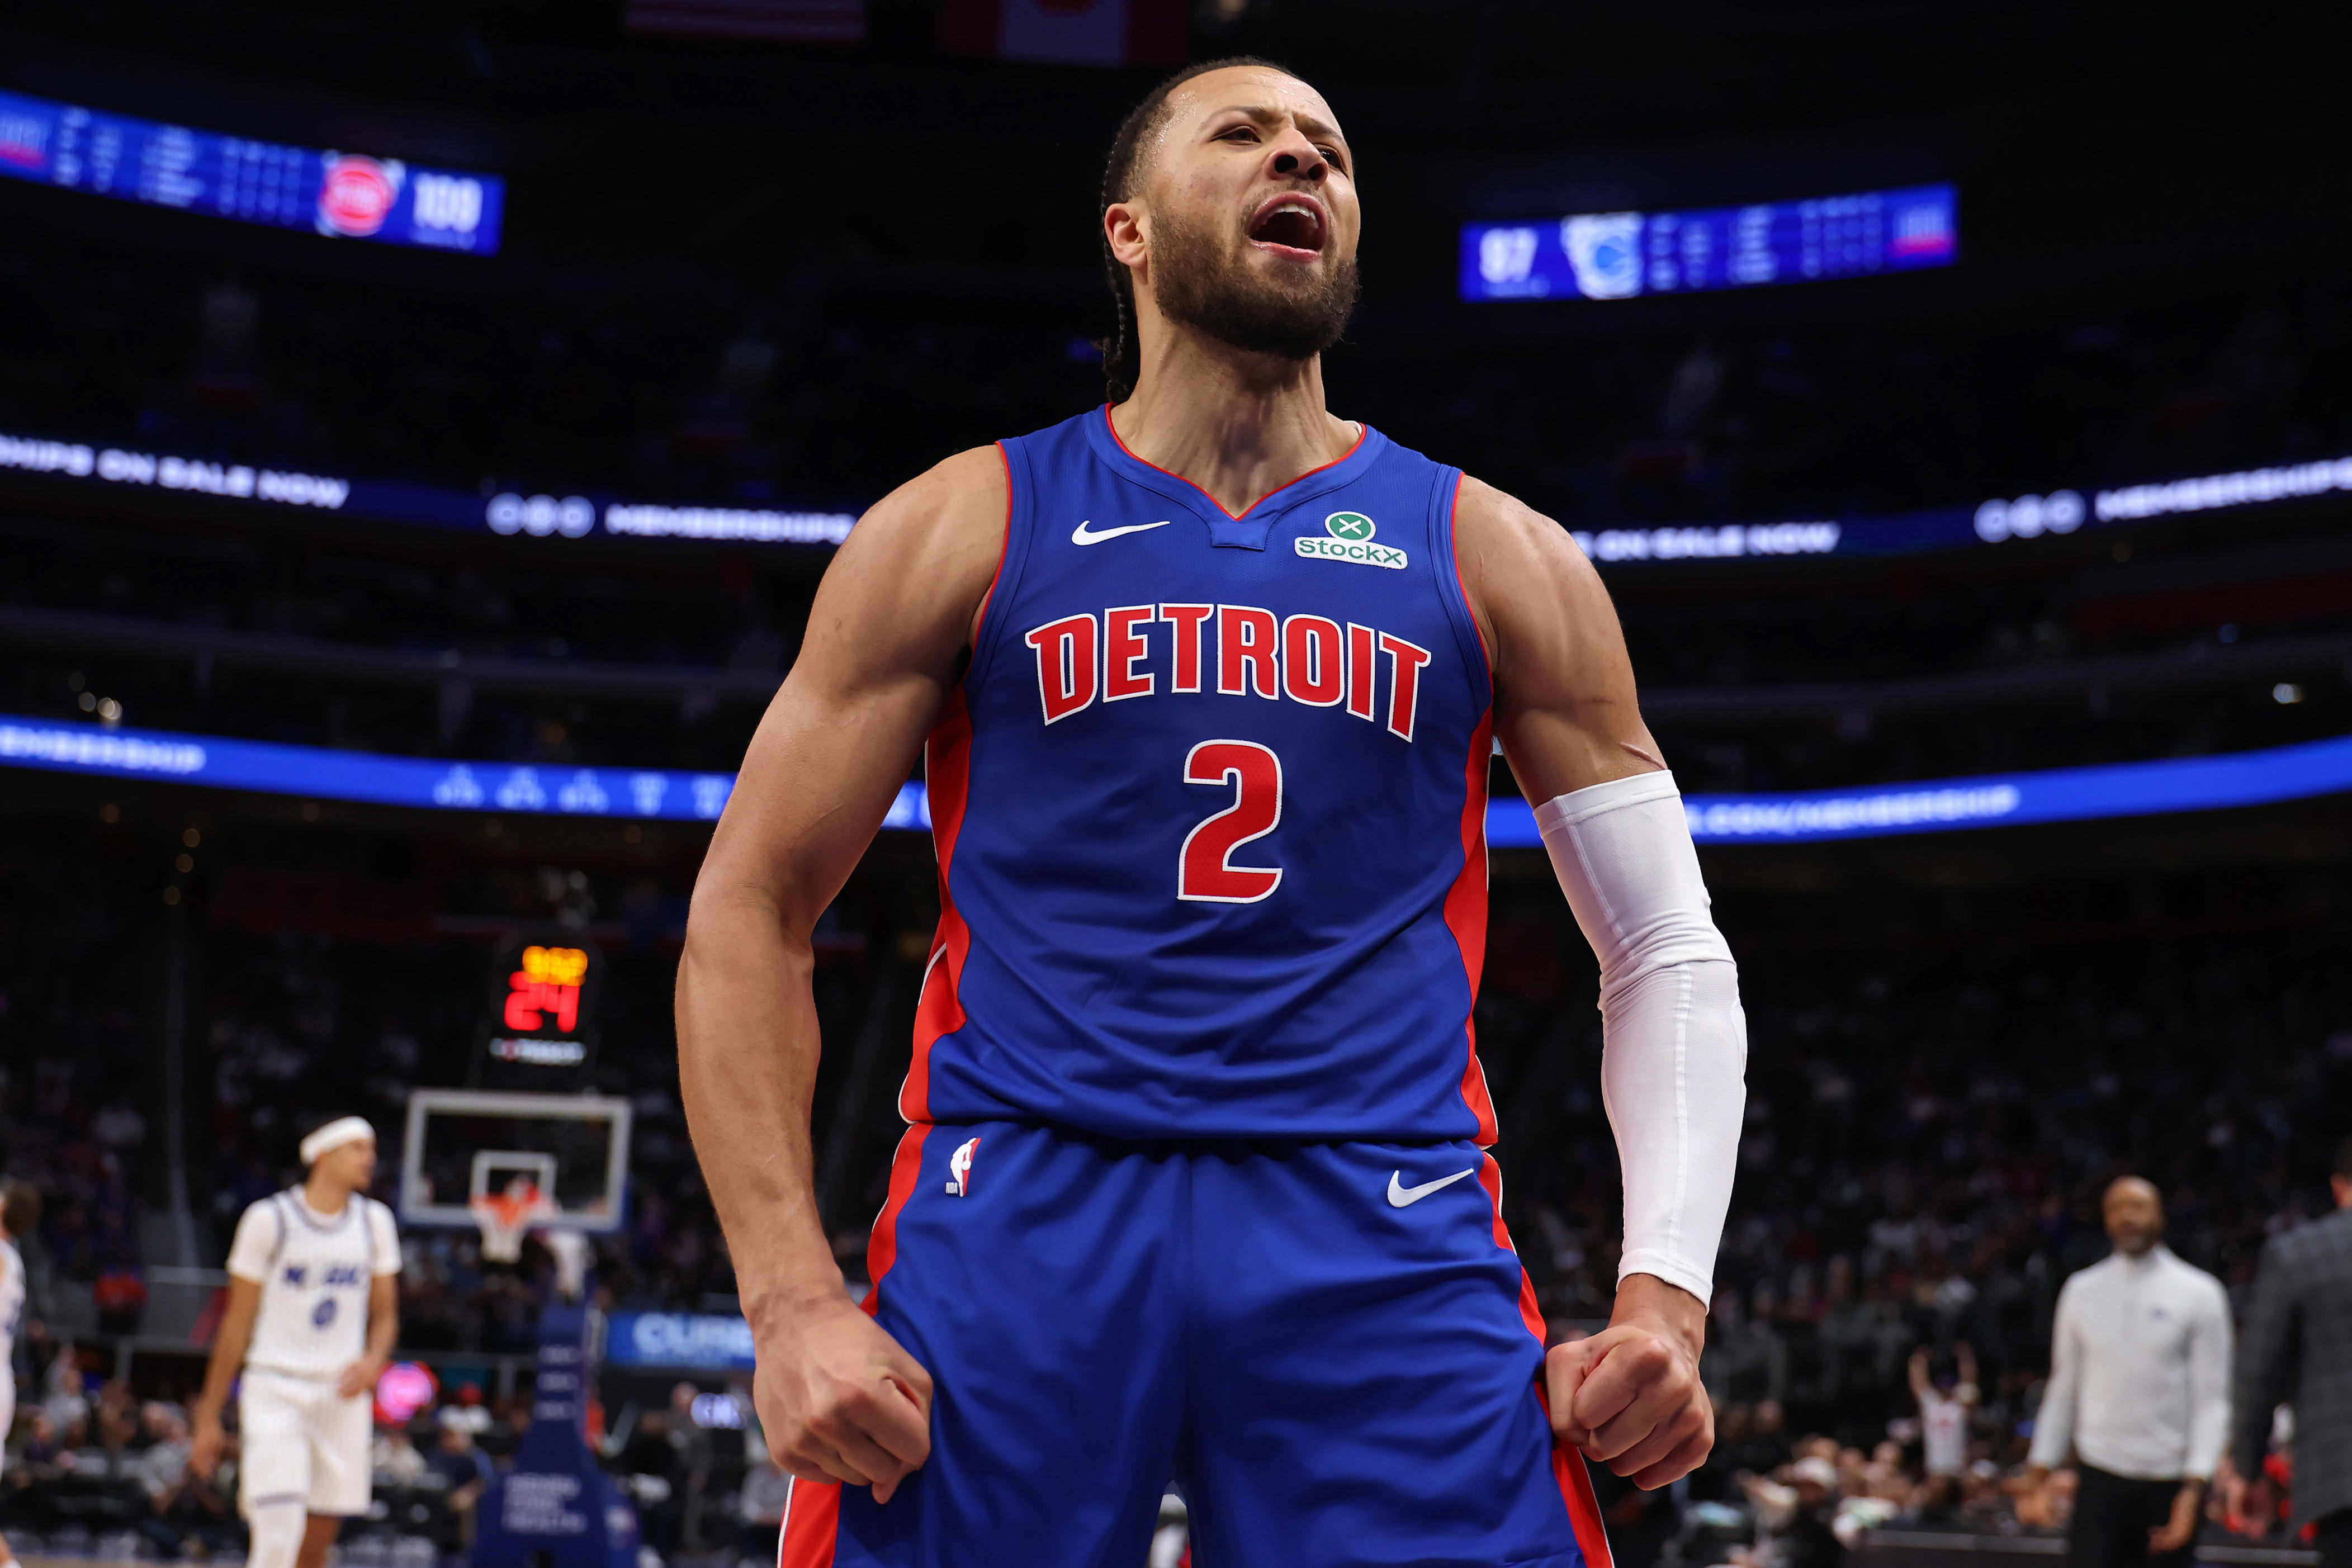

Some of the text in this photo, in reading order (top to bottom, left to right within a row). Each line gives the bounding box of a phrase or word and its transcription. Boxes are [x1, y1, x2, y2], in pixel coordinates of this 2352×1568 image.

[97, 449, 155, 484] ON
[158, 457, 254, 497] SALE
[257, 470, 349, 509] NOW
[1025, 603, 1432, 743] DETROIT
[1177, 739, 1283, 904] 2
[945, 1182, 958, 1194] NBA
